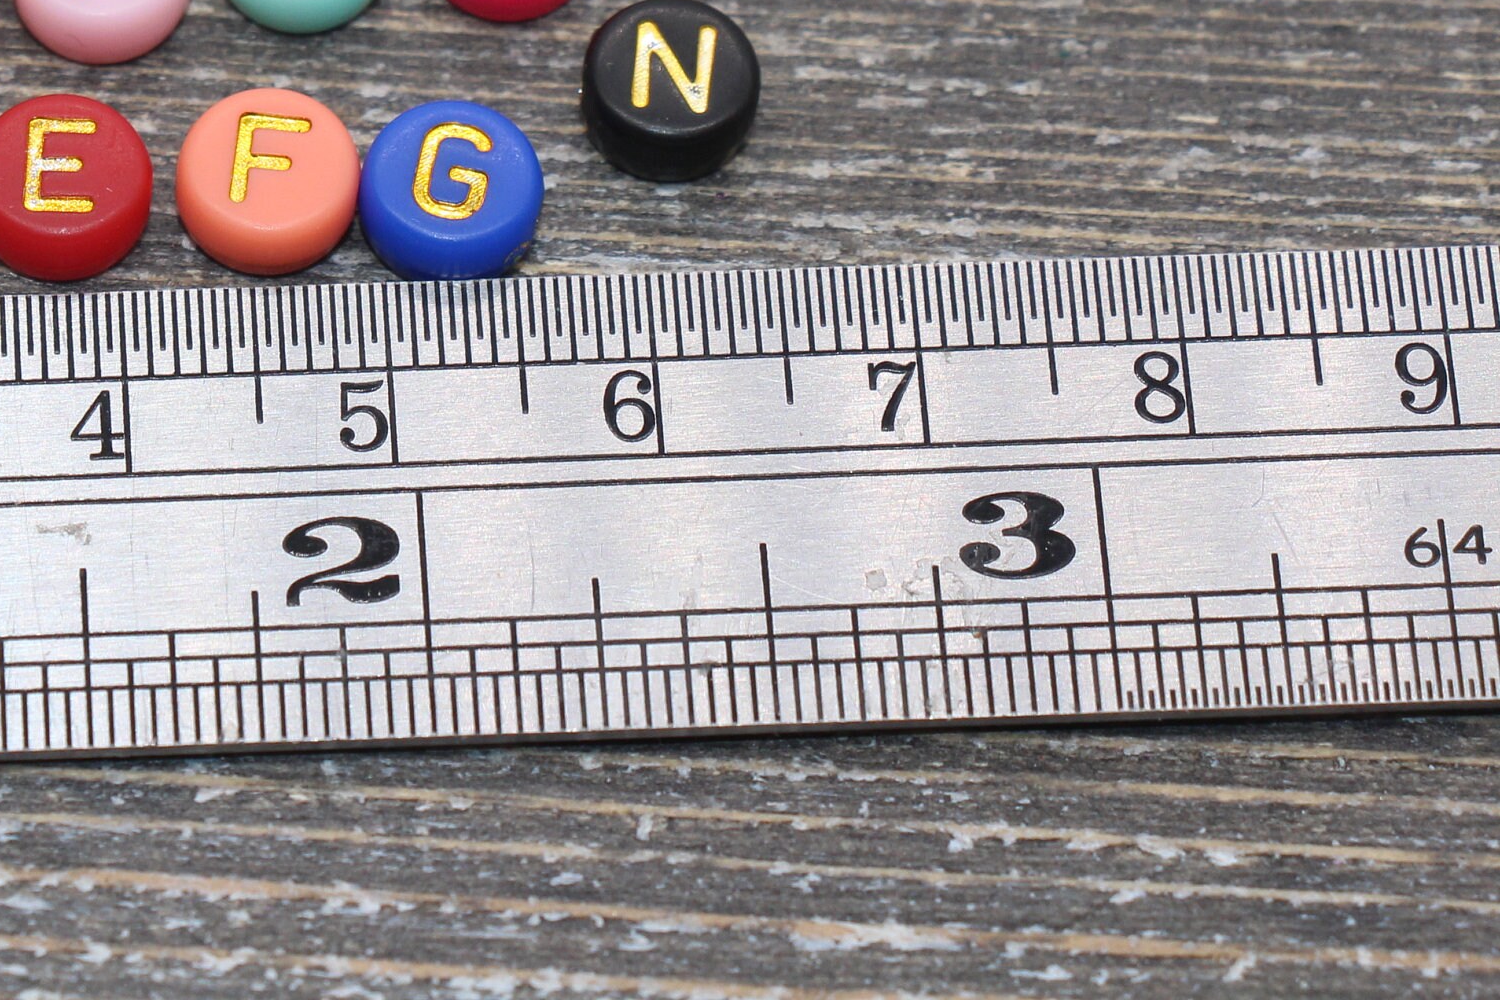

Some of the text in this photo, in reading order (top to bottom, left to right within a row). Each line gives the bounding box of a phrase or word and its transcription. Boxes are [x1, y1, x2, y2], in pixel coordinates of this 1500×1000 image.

[631, 21, 718, 114] N
[24, 116, 97, 213] E
[229, 112, 313, 204] F
[412, 122, 493, 220] G
[70, 390, 126, 461] 4
[339, 380, 389, 454] 5
[603, 369, 656, 444] 6
[867, 360, 917, 432] 7
[1134, 350, 1186, 426] 8
[1395, 342, 1449, 415] 9
[282, 515, 400, 608] 2
[959, 490, 1077, 580] 3
[1404, 523, 1493, 569] 64
